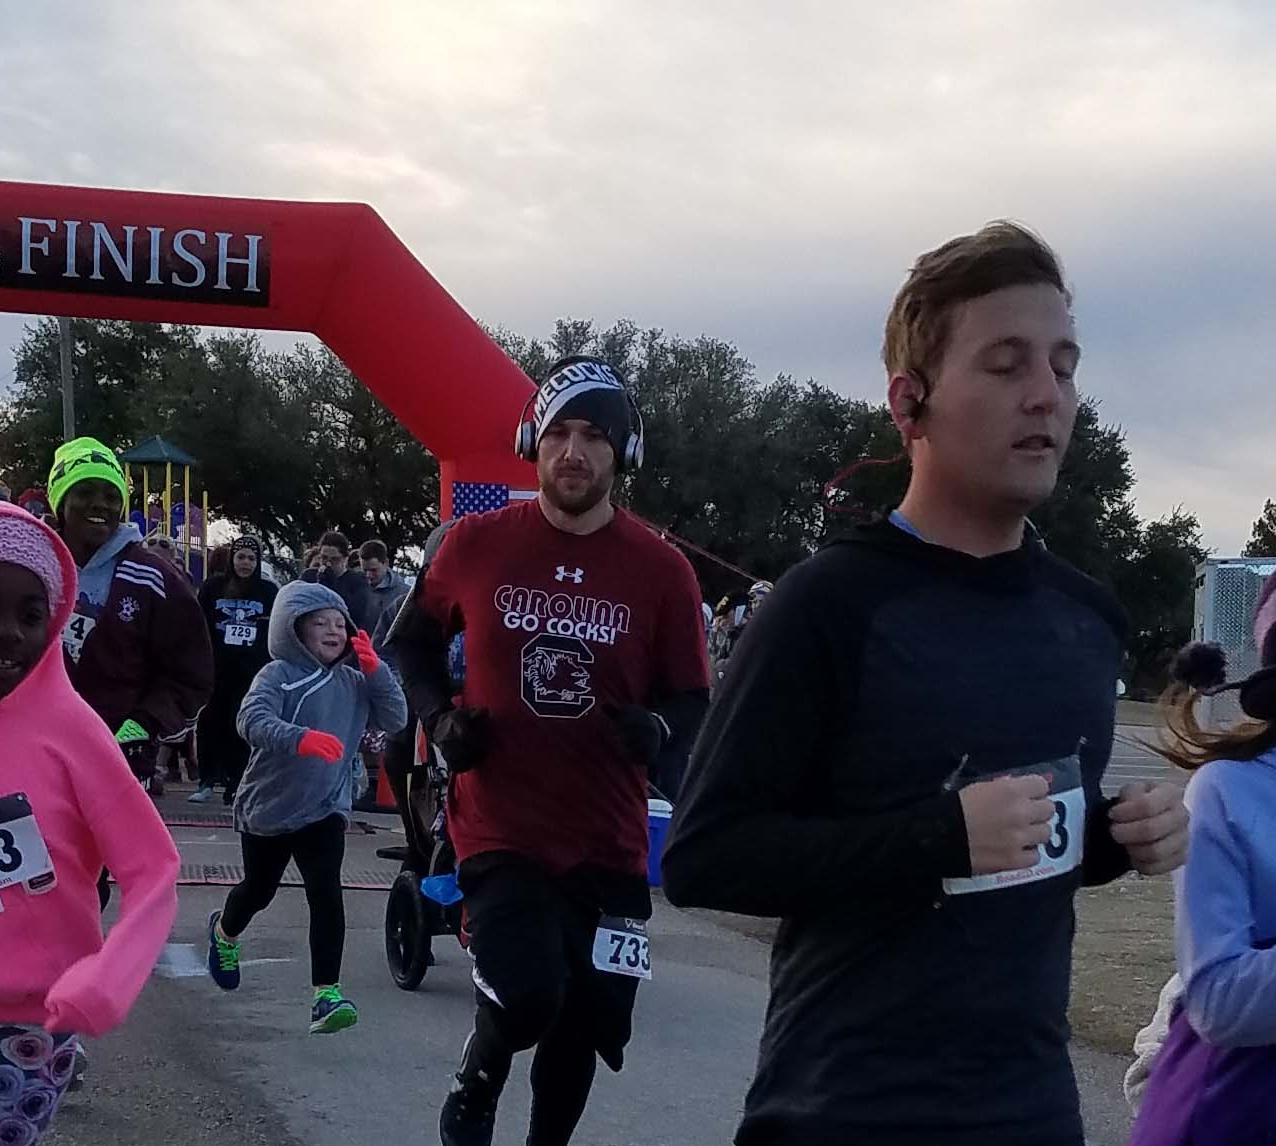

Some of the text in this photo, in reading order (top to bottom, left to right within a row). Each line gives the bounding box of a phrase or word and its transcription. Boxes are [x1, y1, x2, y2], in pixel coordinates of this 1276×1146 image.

[17, 216, 263, 293] FINISH
[494, 585, 631, 633] CAROLINA
[231, 626, 251, 638] 729
[504, 611, 616, 645] GO COCKS!
[609, 933, 651, 970] 733
